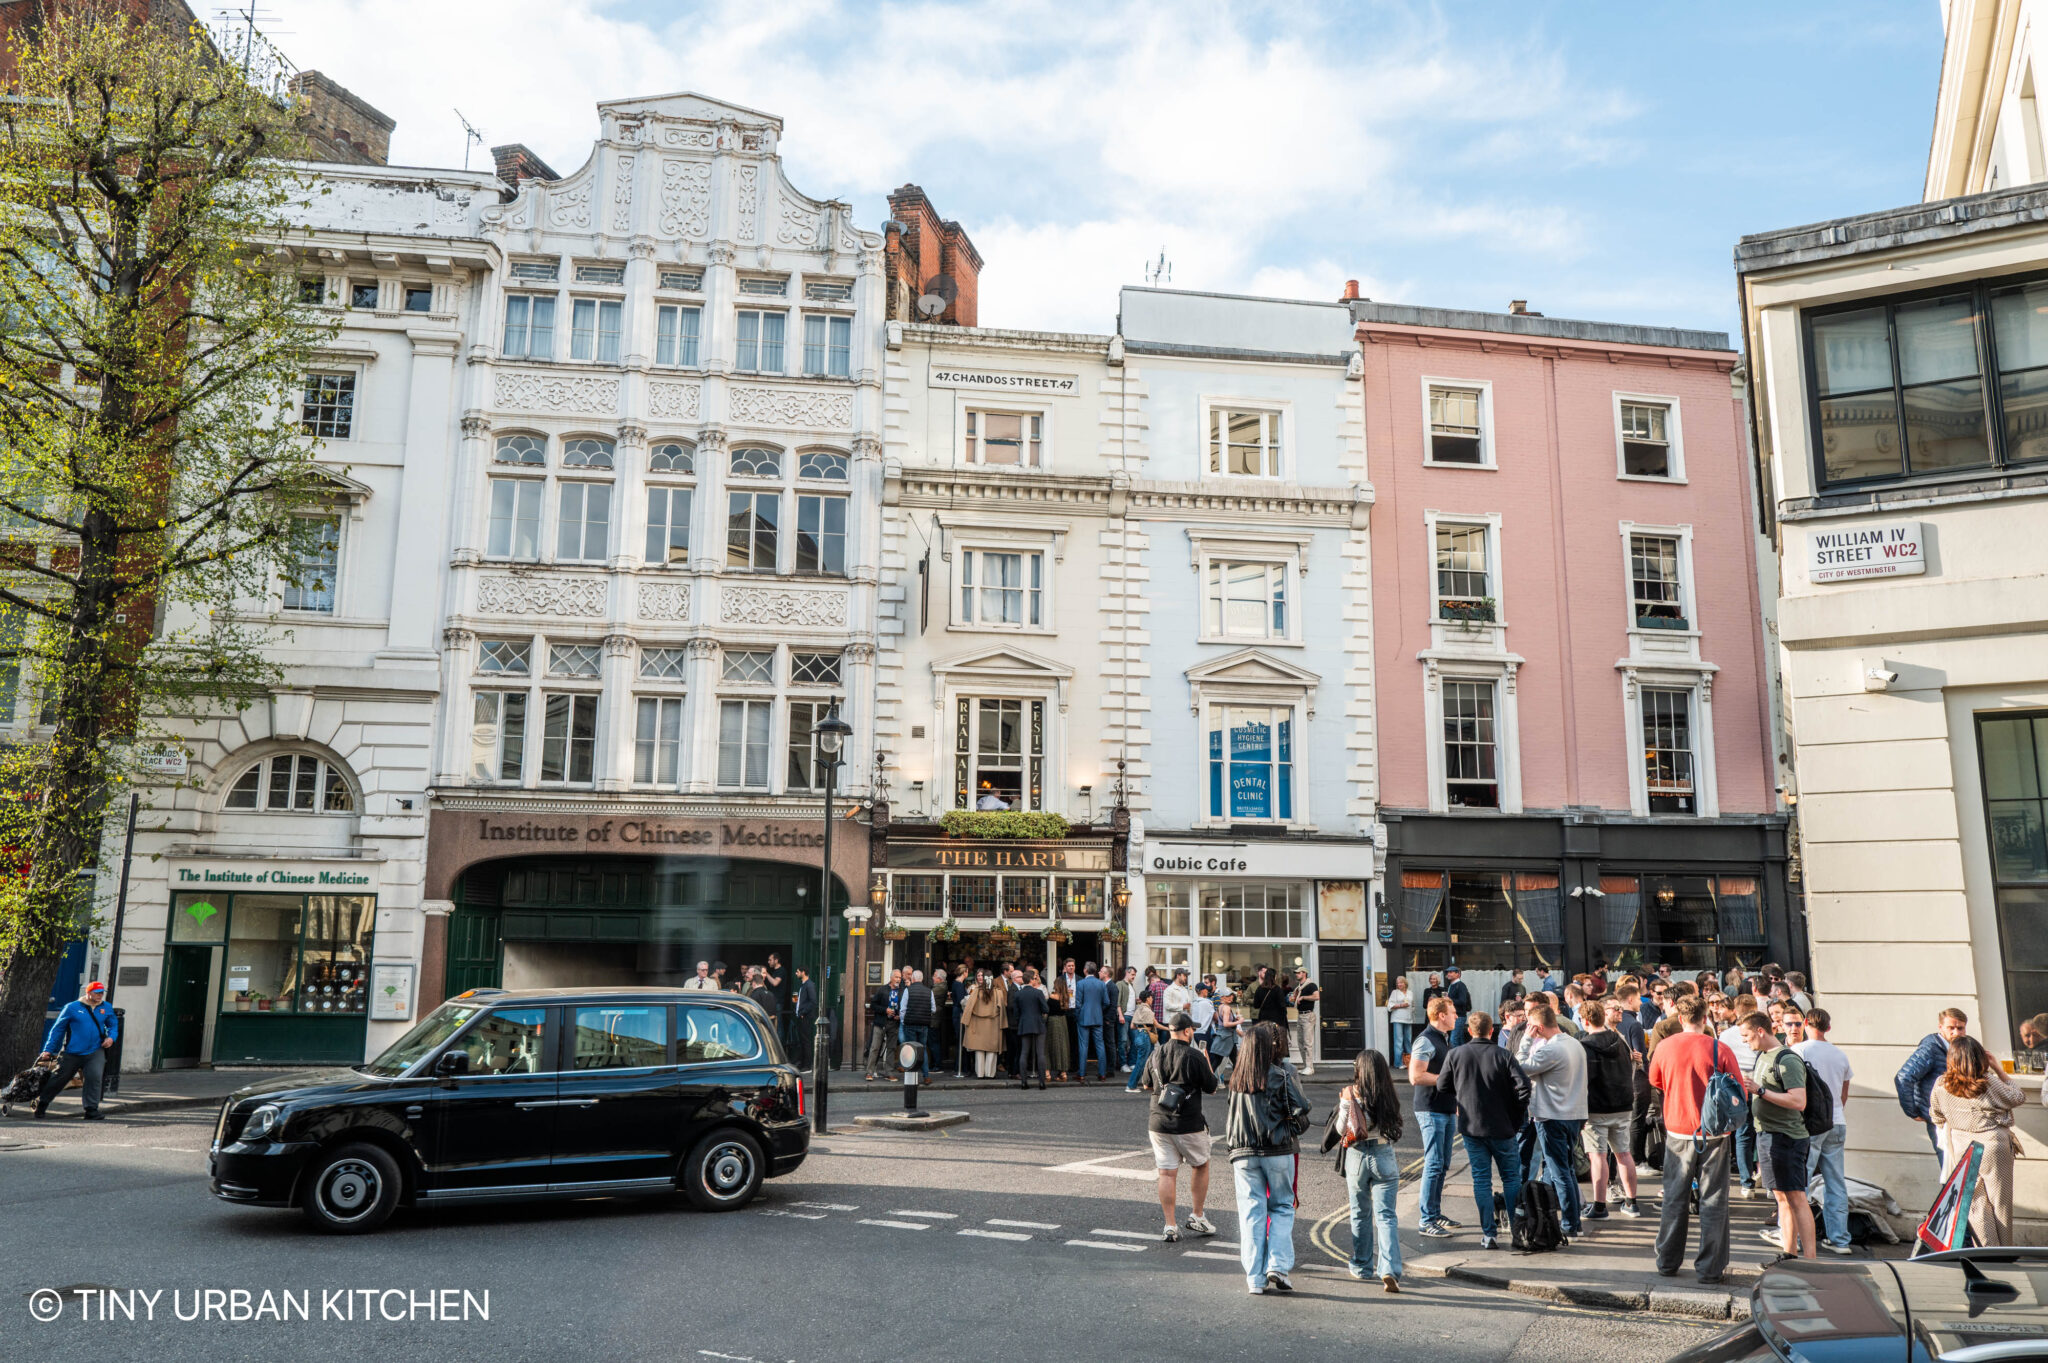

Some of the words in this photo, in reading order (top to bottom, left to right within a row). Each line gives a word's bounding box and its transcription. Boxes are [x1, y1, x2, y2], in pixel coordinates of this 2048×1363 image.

[1816, 530, 1884, 549] WILLIAM
[1891, 528, 1905, 542] IV
[1817, 547, 1873, 564] STREET
[1882, 542, 1918, 558] WC2
[1835, 570, 1845, 578] OF
[1846, 565, 1897, 577] WESTMINSTER
[958, 702, 968, 750] REAL
[1234, 726, 1266, 734] COSMETIC
[1237, 734, 1264, 742] HYGIENE
[141, 757, 163, 766] PLACE
[165, 758, 182, 766] WC2
[957, 758, 967, 806] ALES
[1233, 777, 1266, 790] DENTAL
[1237, 791, 1264, 800] CLINIC
[479, 818, 578, 842] Institute
[586, 820, 613, 843] of
[619, 821, 713, 846] Chinese
[722, 824, 825, 848] Medicine
[936, 850, 988, 866] THE
[995, 851, 1065, 867] HARP
[1153, 857, 1203, 870] Qubic
[1207, 858, 1247, 871] Cafe
[178, 868, 201, 882] The
[204, 868, 254, 883] Institute
[256, 870, 269, 883] of
[271, 870, 315, 884] Chinese
[318, 871, 369, 885] Medicine
